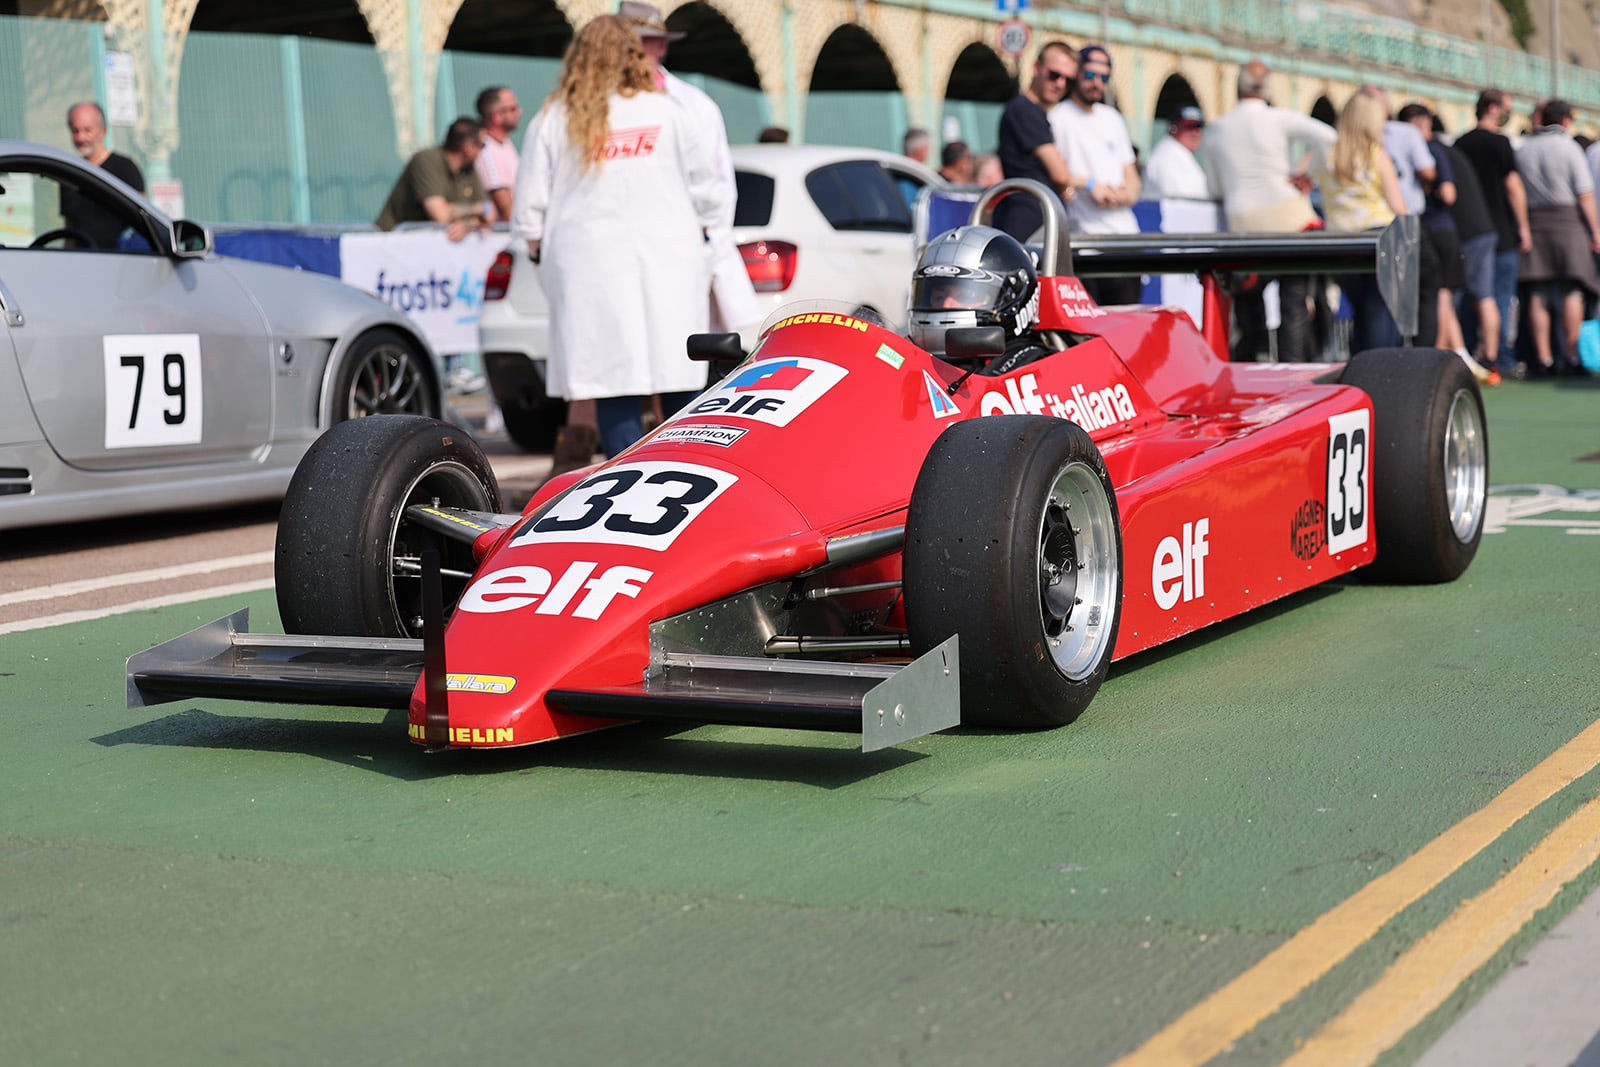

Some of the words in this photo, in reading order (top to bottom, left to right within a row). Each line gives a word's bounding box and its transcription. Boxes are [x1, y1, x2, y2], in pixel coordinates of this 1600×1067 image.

[772, 313, 869, 333] MICHELIN
[120, 353, 186, 430] 79
[688, 395, 786, 416] elf
[657, 429, 737, 441] CHAMPION
[1152, 517, 1210, 611] elf
[458, 560, 655, 621] elf
